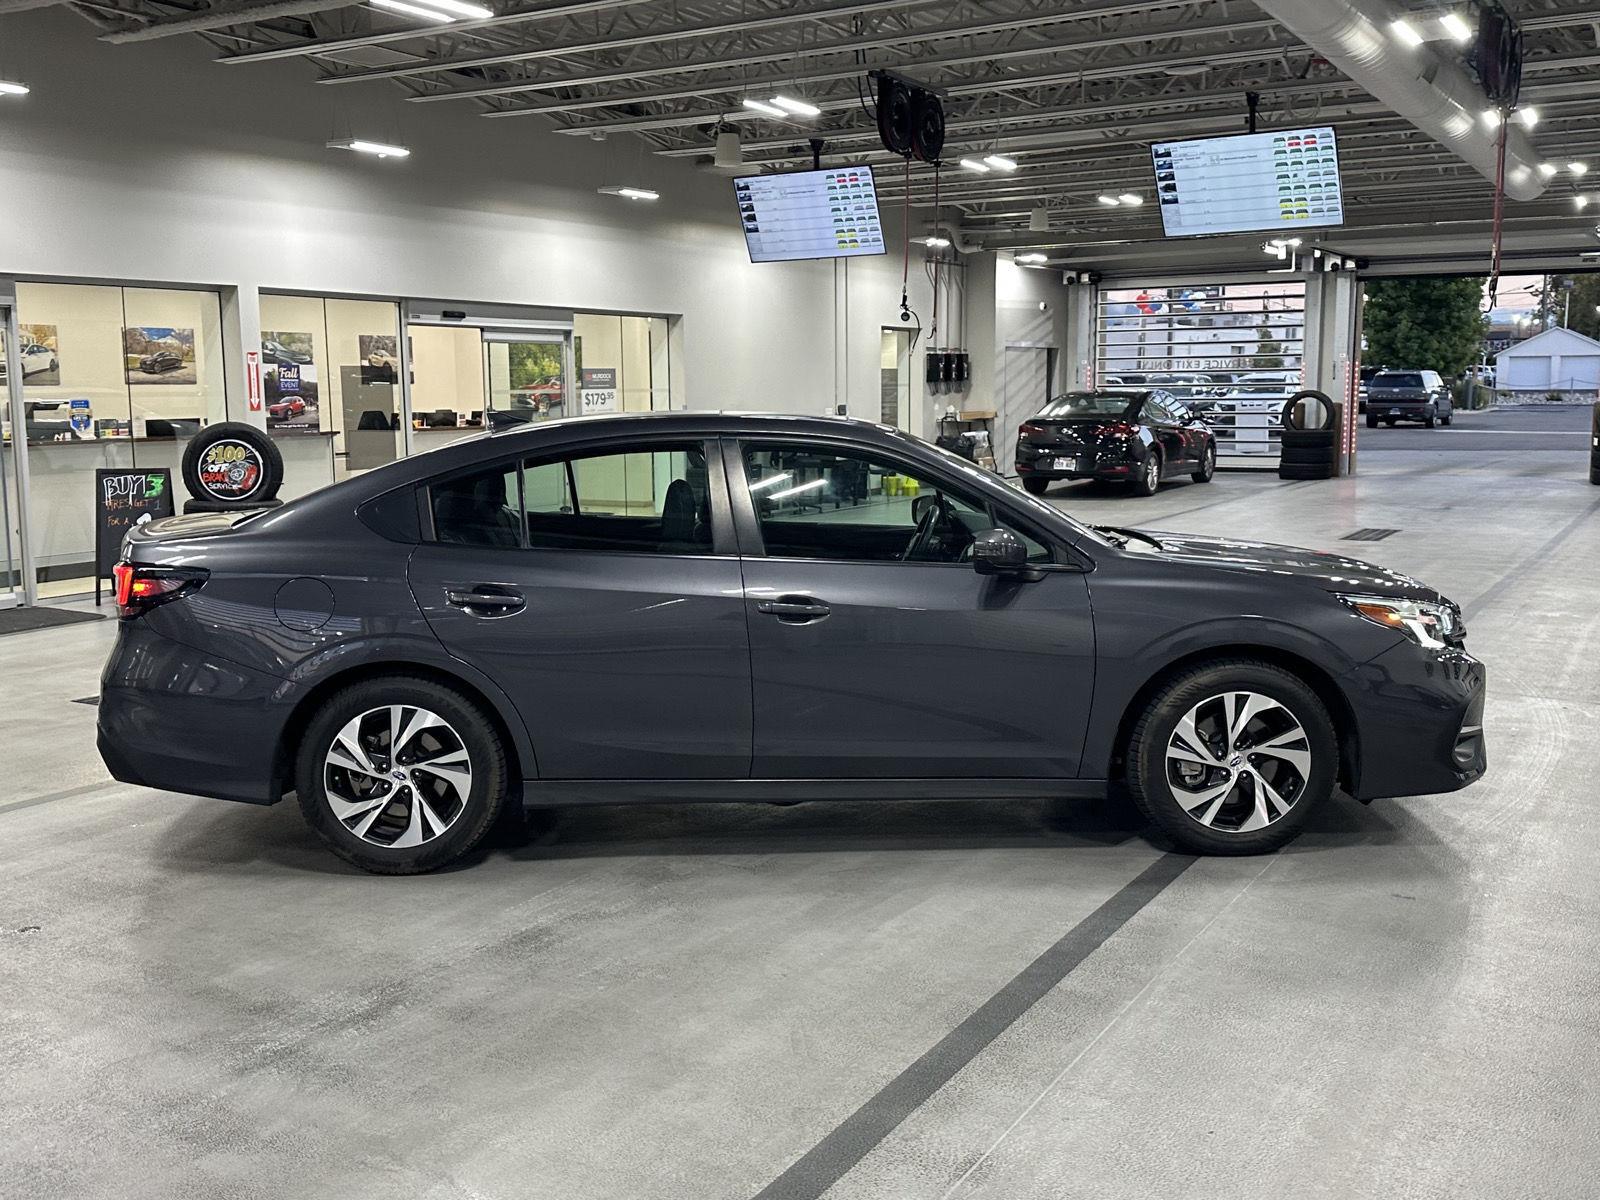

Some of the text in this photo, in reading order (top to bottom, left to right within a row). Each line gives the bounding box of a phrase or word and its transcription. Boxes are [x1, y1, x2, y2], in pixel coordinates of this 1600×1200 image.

[279, 367, 299, 378] Fall
[207, 445, 246, 463] $100
[208, 463, 229, 472] OFF
[103, 474, 164, 503] BUY 3
